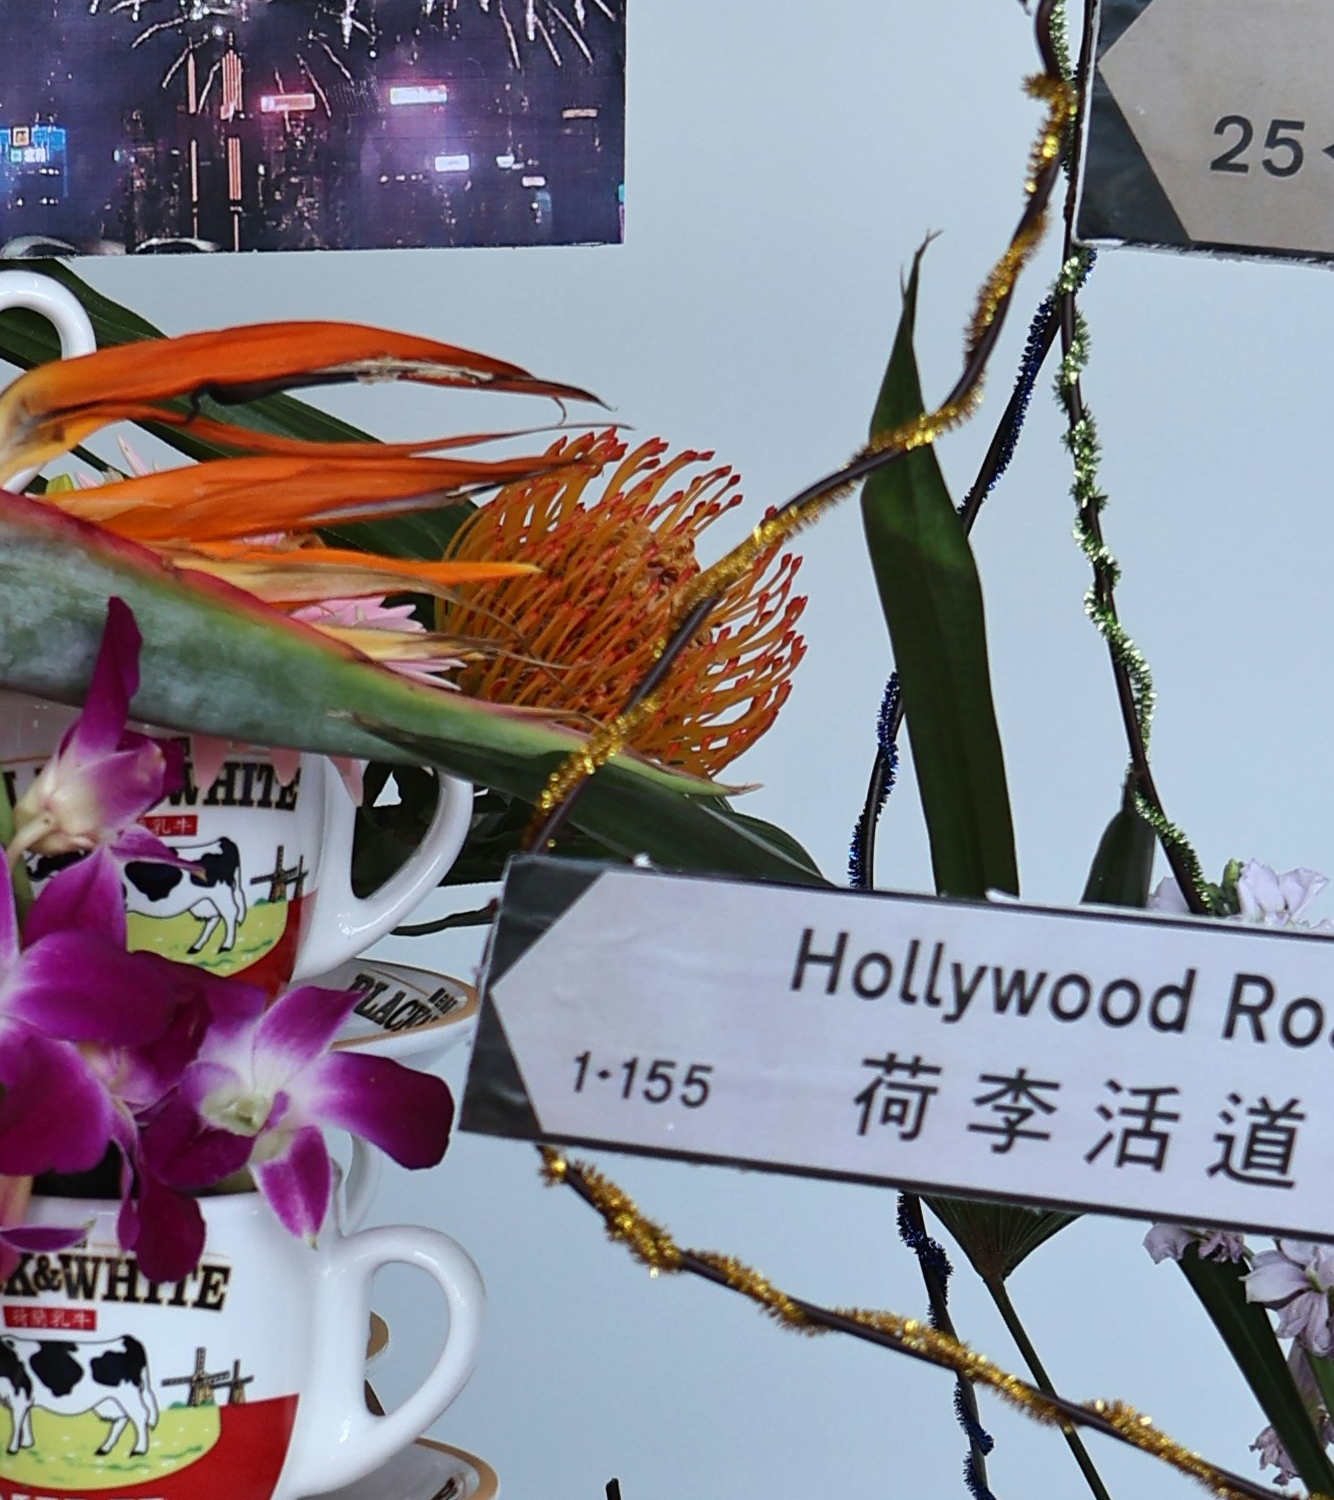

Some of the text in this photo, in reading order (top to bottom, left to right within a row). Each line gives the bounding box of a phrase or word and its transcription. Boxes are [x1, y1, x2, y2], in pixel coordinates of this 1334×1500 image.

[791, 930, 1198, 1036] Hollywood
[851, 1051, 1304, 1191] 荷李活道
